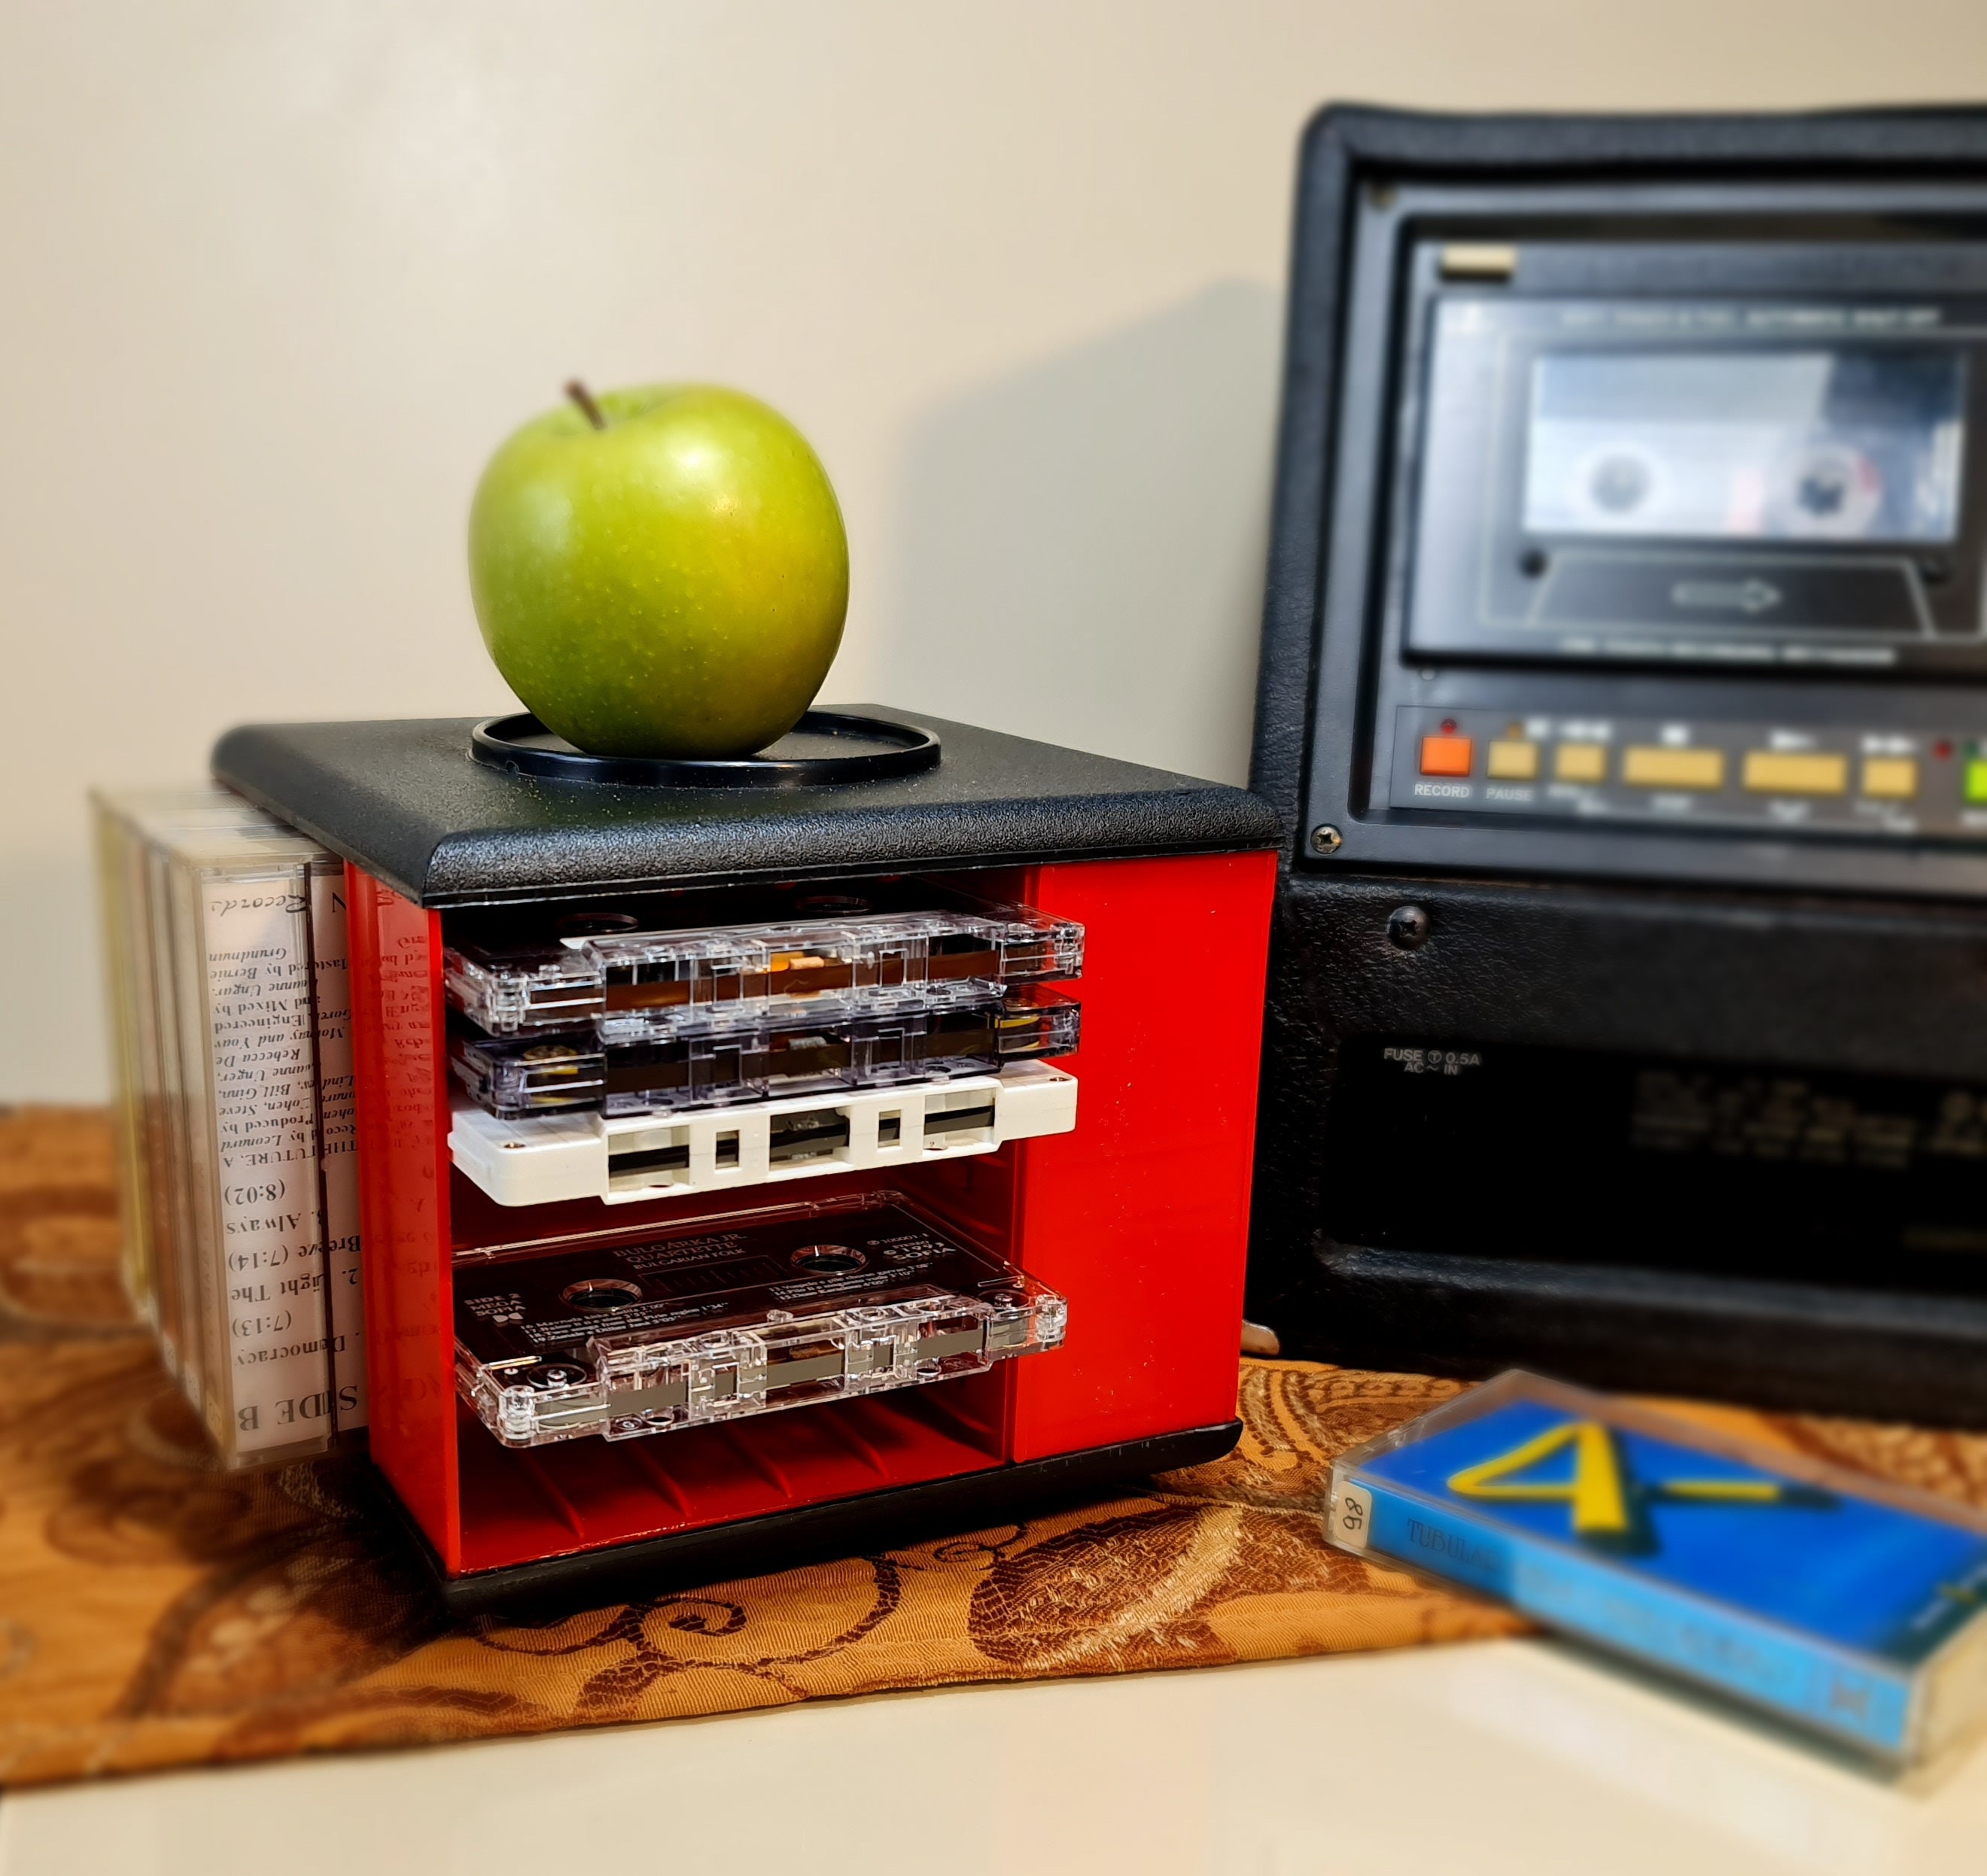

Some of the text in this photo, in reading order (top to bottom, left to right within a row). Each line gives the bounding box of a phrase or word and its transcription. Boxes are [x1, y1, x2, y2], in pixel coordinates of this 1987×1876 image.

[1414, 783, 1470, 799] RECORD
[1486, 787, 1532, 801] PAUSE
[208, 947, 286, 962] Grundman
[210, 968, 257, 981] Bernie
[265, 964, 281, 977] by
[211, 984, 260, 996] Ungar.
[213, 1002, 230, 1016] by
[238, 999, 287, 1015] Mixed
[214, 1014, 305, 1032] Engineered
[214, 1037, 250, 1049] Yoav
[258, 1034, 285, 1047] and
[215, 1048, 300, 1067] Rebecca De
[1384, 1048, 1423, 1061] FUSE
[1445, 1052, 1480, 1065] 0.5A
[1404, 1063, 1458, 1075] AC IN
[218, 1088, 257, 1099] Ginn,
[264, 1084, 291, 1097] Bill
[218, 1105, 257, 1117] Steve
[221, 1123, 238, 1134] by
[245, 1113, 313, 1133] Produced
[220, 1124, 355, 1152] Recod by Leonard
[223, 1157, 233, 1167] A
[224, 1179, 285, 1206] (8:02)
[226, 1213, 301, 1235] Always
[228, 1245, 288, 1271] (7:14)
[626, 1242, 738, 1263] QUARTETTE
[893, 1248, 956, 1260] SOFIA
[342, 1268, 358, 1285] 2.
[231, 1285, 270, 1303] The
[464, 1296, 505, 1305] SIDE
[470, 1300, 522, 1310] MEGA
[476, 1306, 526, 1317] SOFIA
[232, 1310, 292, 1337] (7:13)
[238, 1406, 259, 1431] B
